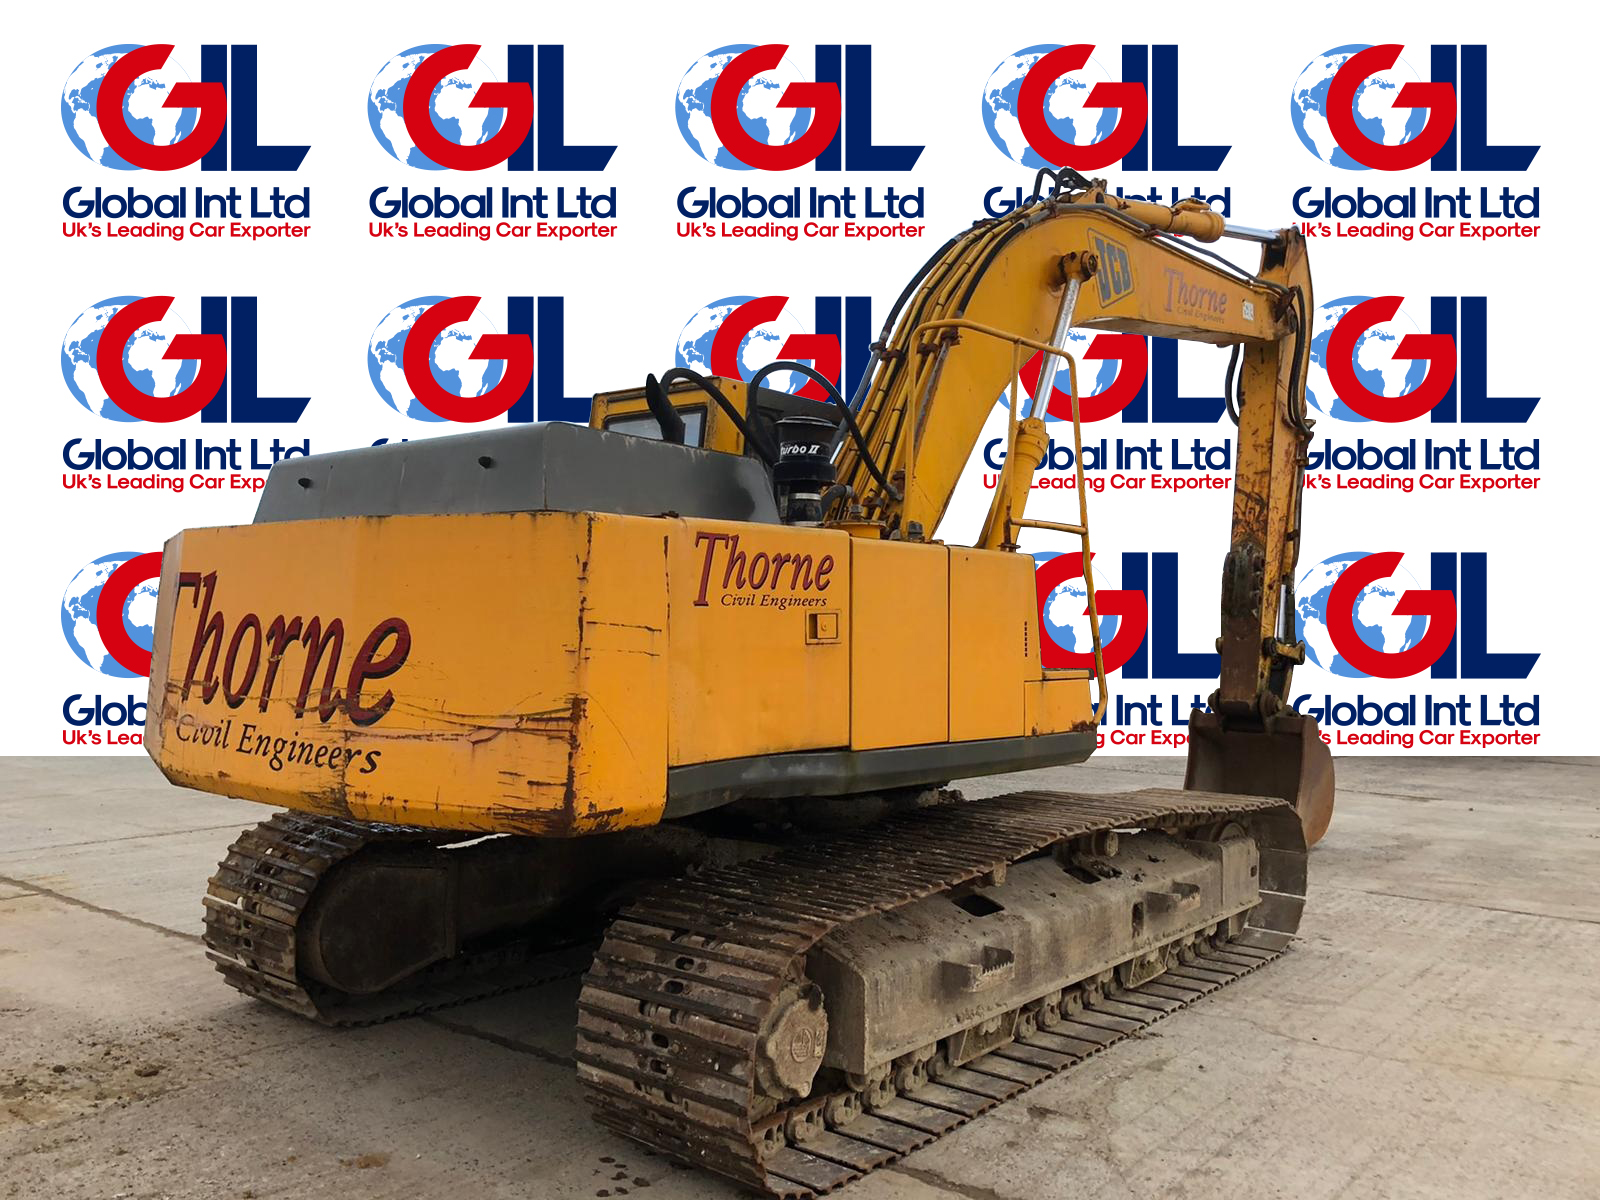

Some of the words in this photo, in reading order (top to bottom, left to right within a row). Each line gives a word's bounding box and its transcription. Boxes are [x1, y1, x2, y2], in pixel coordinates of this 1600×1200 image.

[1094, 235, 1132, 302] JCB
[1162, 265, 1228, 314] Thorne
[693, 531, 835, 607] Thorne
[720, 593, 756, 607] Civil
[760, 594, 828, 611] Engineers
[175, 713, 232, 750] Civil
[235, 723, 382, 774] Engineers
